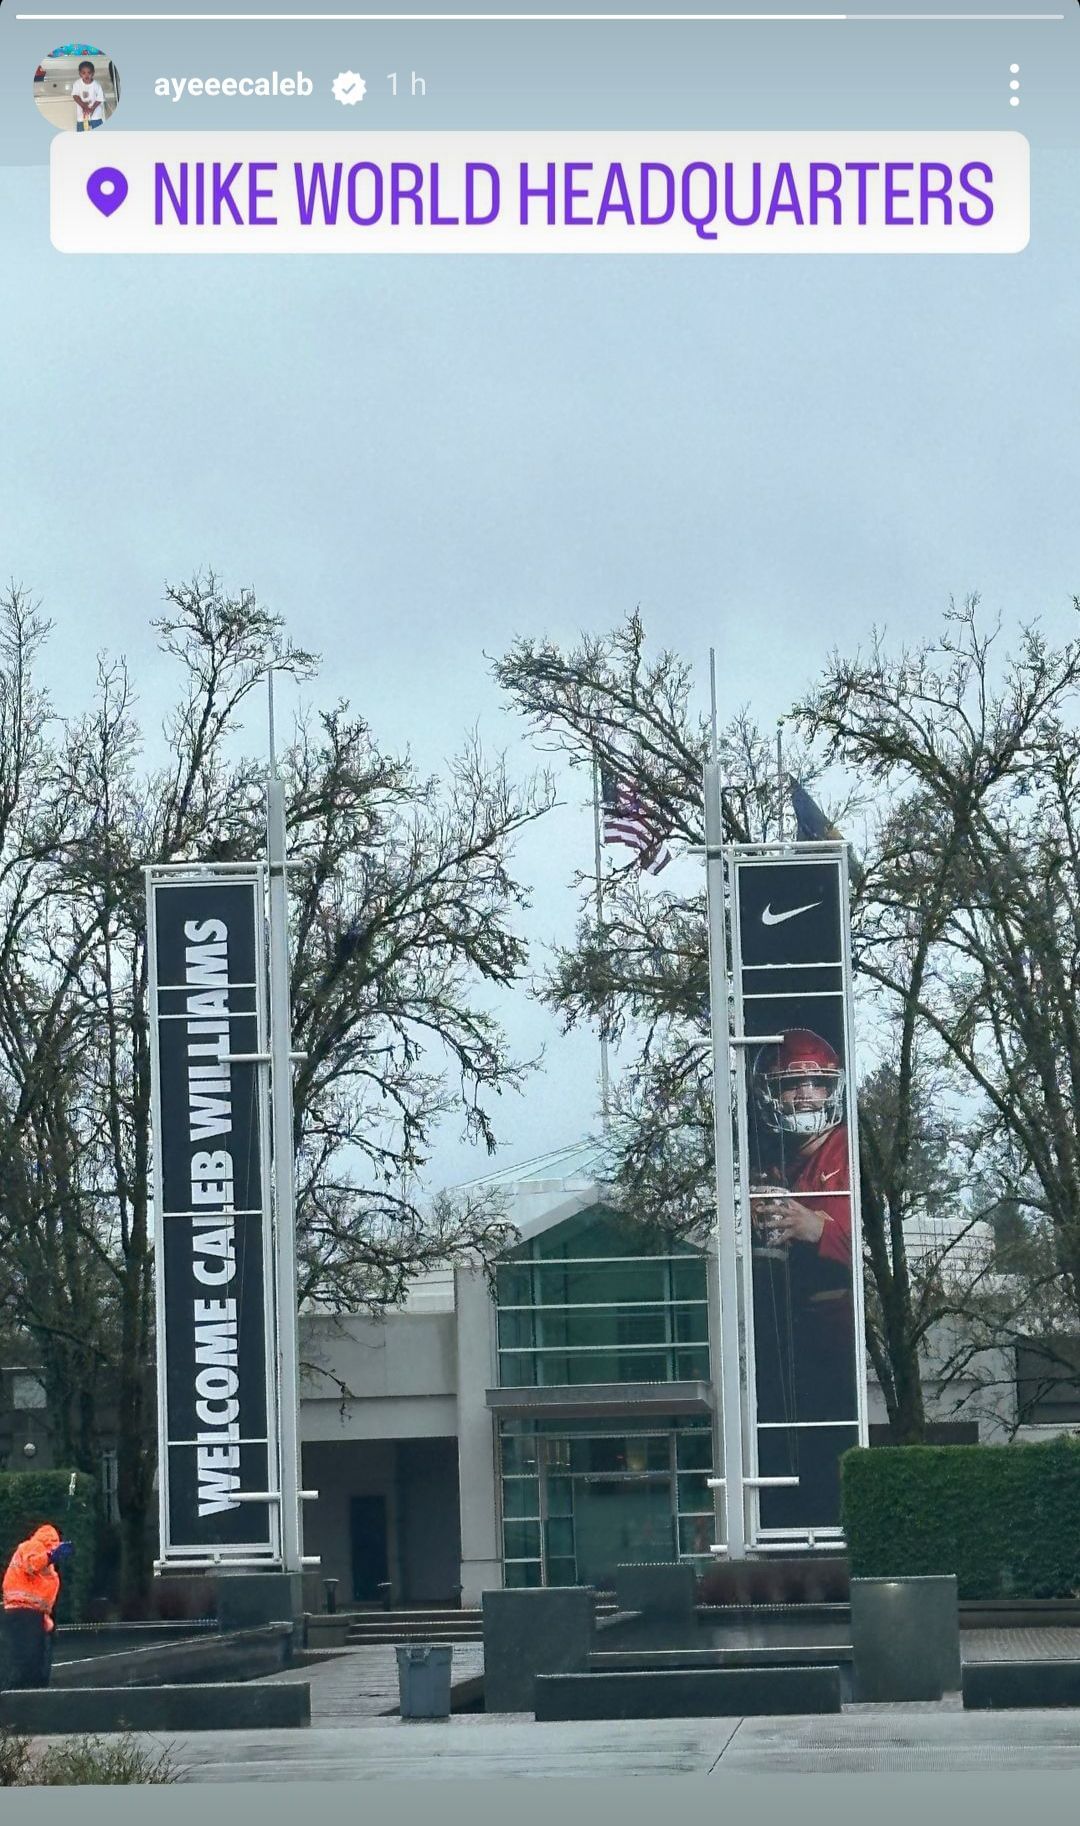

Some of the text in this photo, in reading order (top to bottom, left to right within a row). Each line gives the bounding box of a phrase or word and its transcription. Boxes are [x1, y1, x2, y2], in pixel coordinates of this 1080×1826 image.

[184, 918, 241, 1518] WELCOME CALEB WILLIAMS
